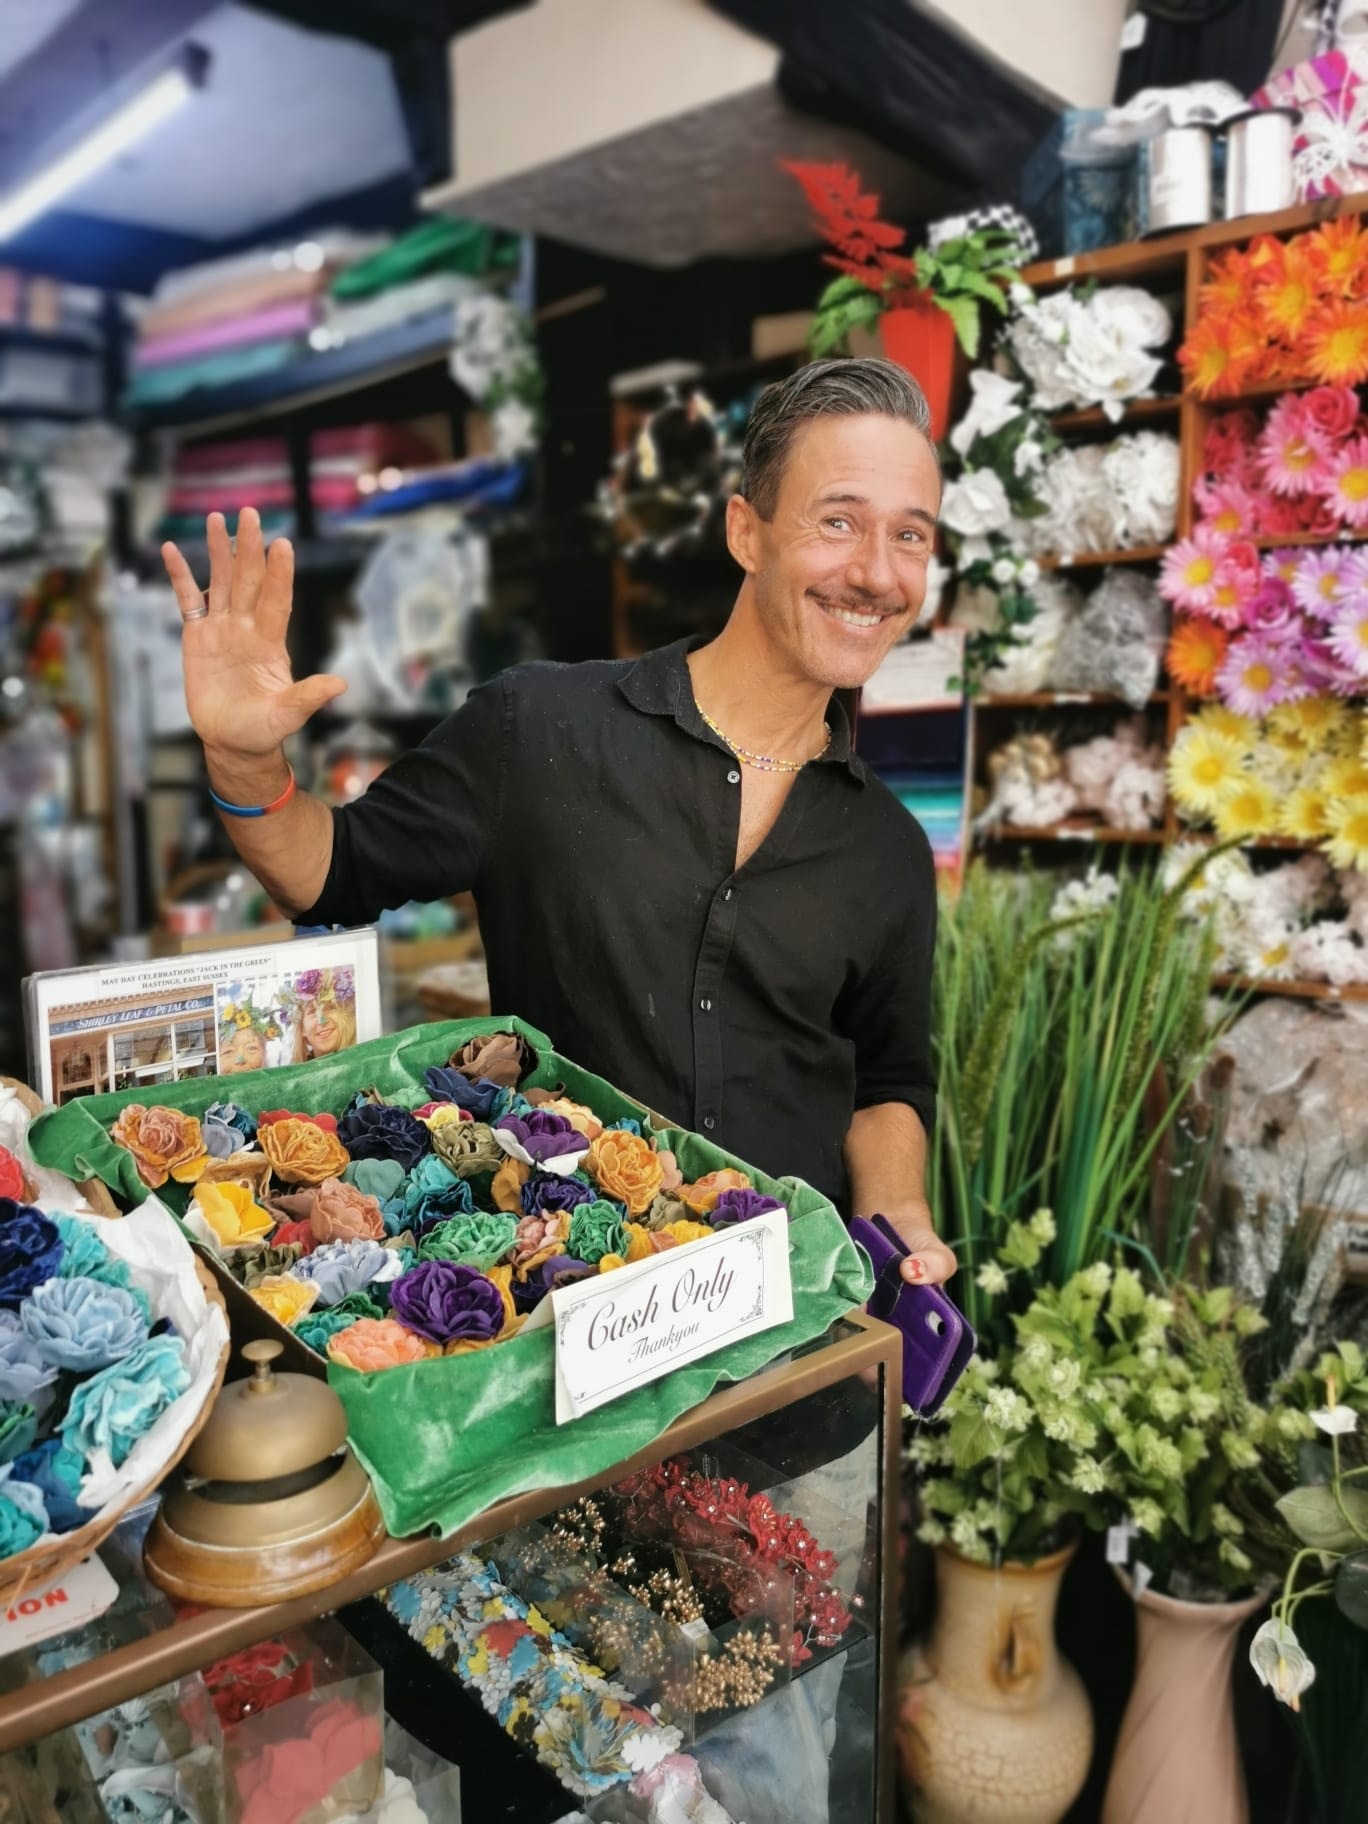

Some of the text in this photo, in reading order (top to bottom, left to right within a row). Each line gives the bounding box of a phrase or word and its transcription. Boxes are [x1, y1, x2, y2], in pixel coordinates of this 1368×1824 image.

[102, 977, 119, 986] MAY
[121, 975, 136, 984] DAY
[138, 968, 195, 981] CELEBRATIONS
[184, 975, 201, 984] EAST
[203, 972, 229, 981] SUSSEX
[77, 1014, 118, 1029] SHIRLEY
[120, 1009, 144, 1021] LEAF
[155, 1004, 183, 1015] PETAL
[588, 1256, 734, 1351] Cash Only
[628, 1320, 700, 1363] Thankyou
